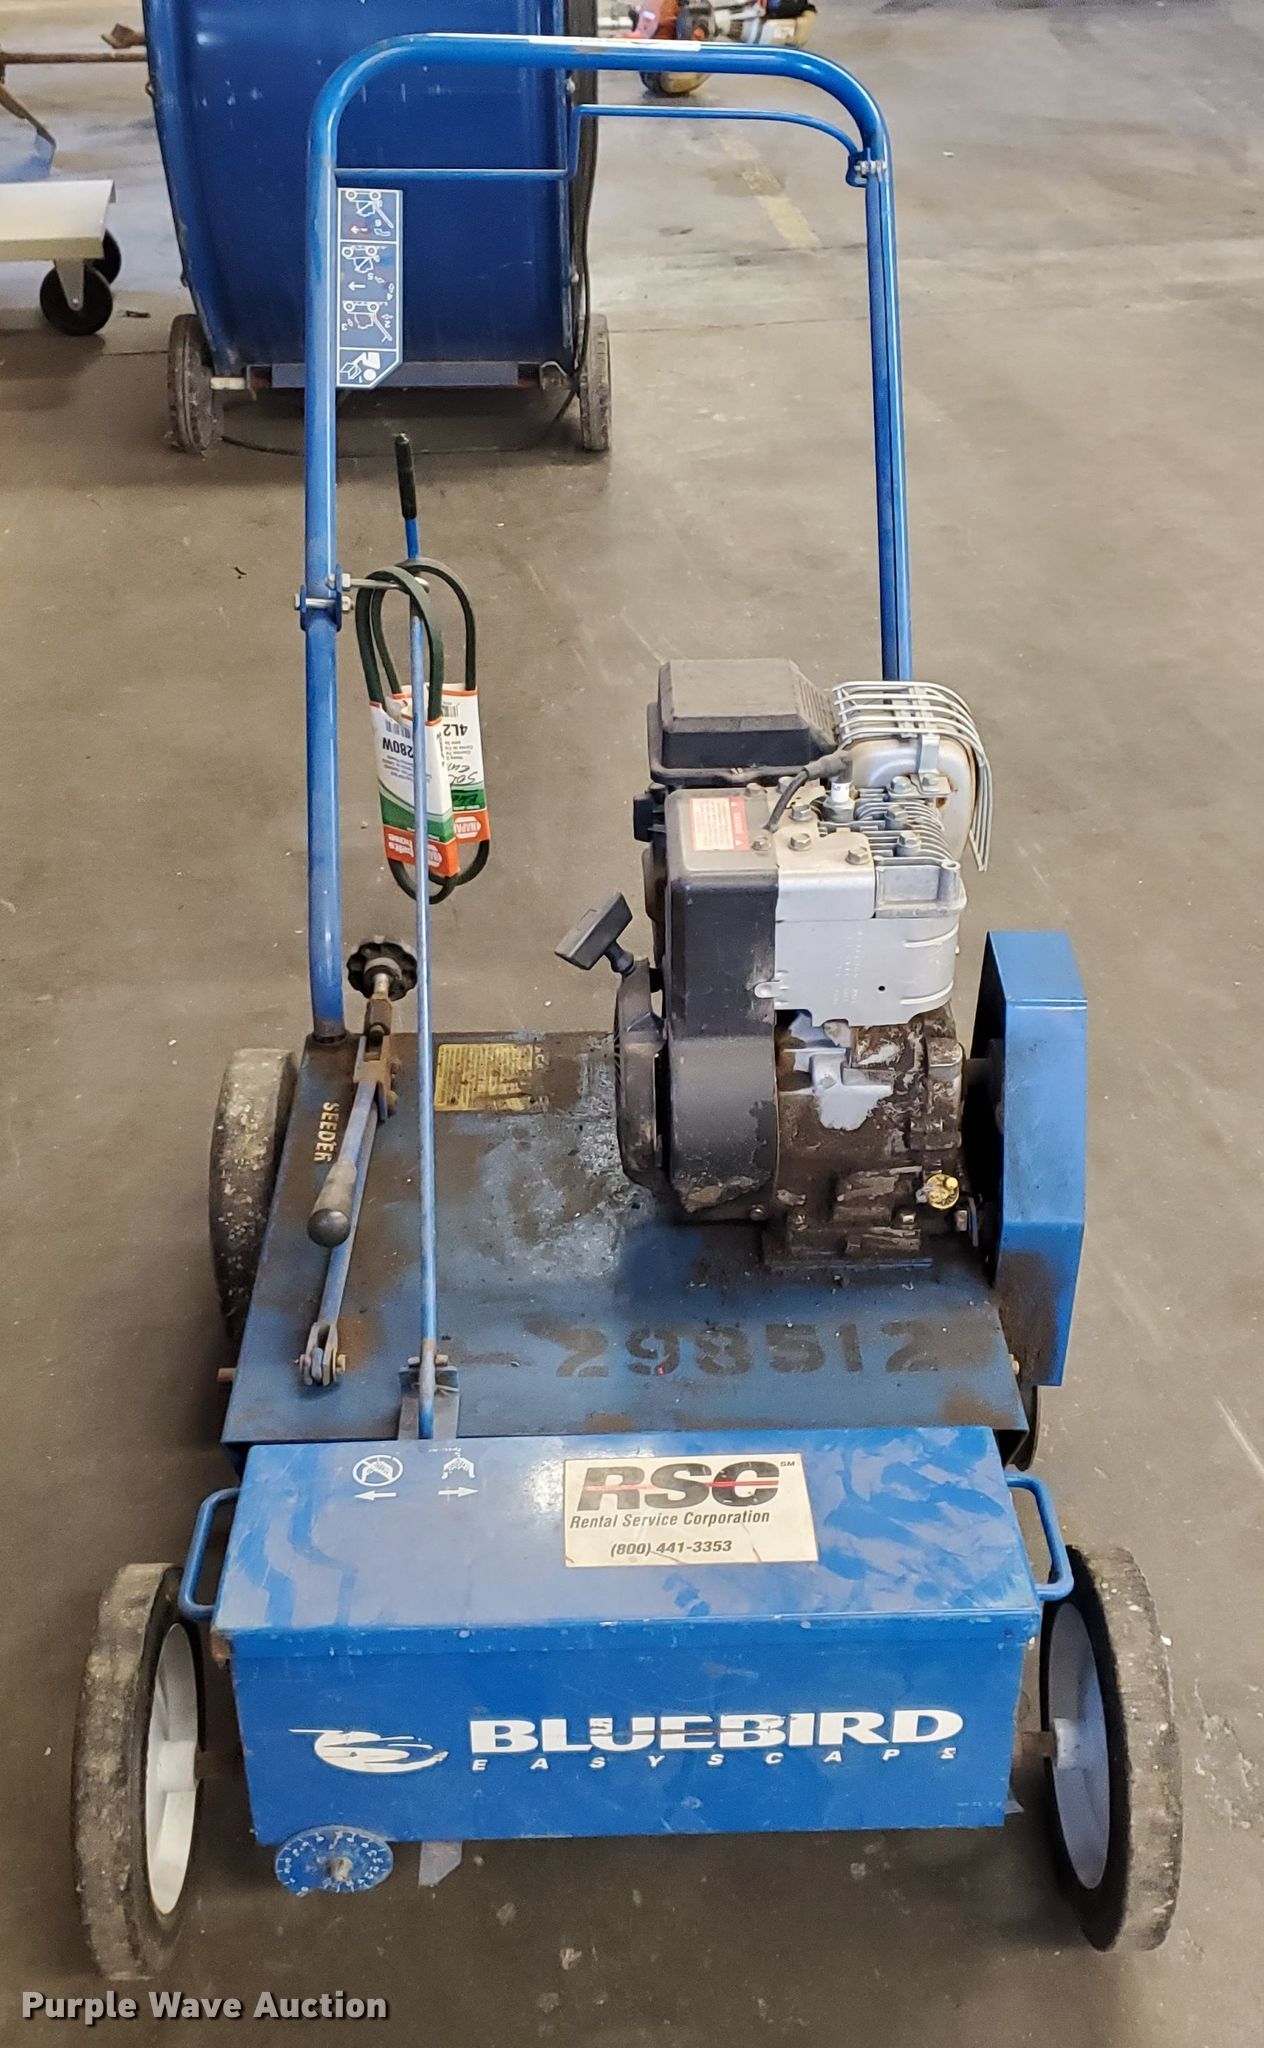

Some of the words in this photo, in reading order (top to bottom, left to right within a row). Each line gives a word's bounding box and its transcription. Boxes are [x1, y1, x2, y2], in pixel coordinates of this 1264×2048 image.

[314, 1102, 340, 1162] SEEDER
[577, 1461, 779, 1511] RSC
[569, 1514, 618, 1529] Rental
[622, 1513, 678, 1528] Service
[683, 1510, 771, 1527] Corporation
[610, 1542, 651, 1557] (800)
[656, 1540, 733, 1554] 441-3353
[469, 1709, 964, 1754] BLUEBIRD
